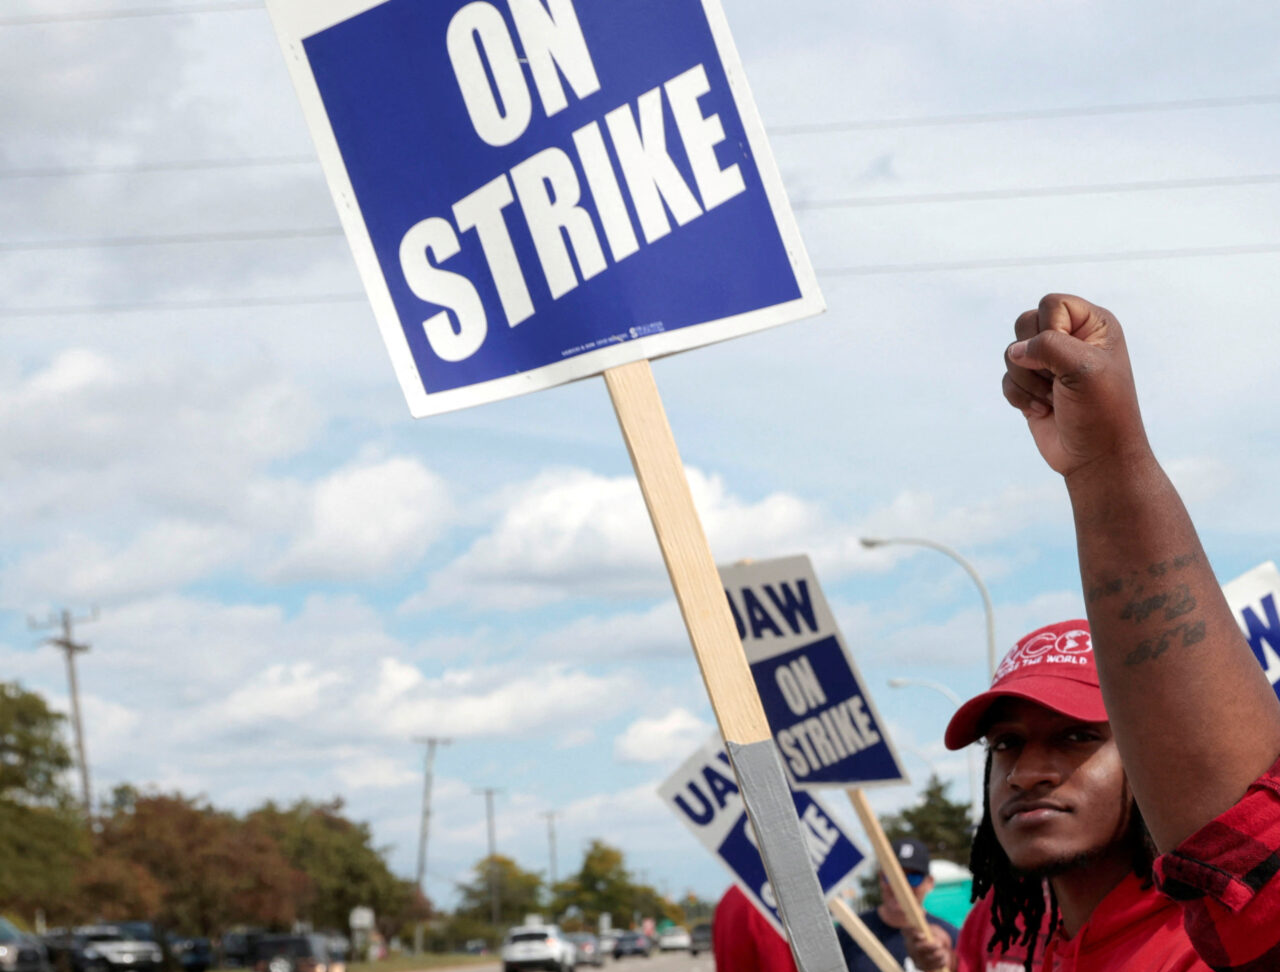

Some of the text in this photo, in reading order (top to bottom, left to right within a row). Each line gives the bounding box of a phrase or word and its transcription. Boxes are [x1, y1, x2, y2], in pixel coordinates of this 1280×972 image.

[446, 0, 601, 147] ON
[399, 63, 747, 362] STRIKE
[775, 655, 826, 717] ON
[1046, 654, 1088, 665] WORLD
[776, 695, 881, 778] STRIKE
[673, 751, 740, 826] UA
